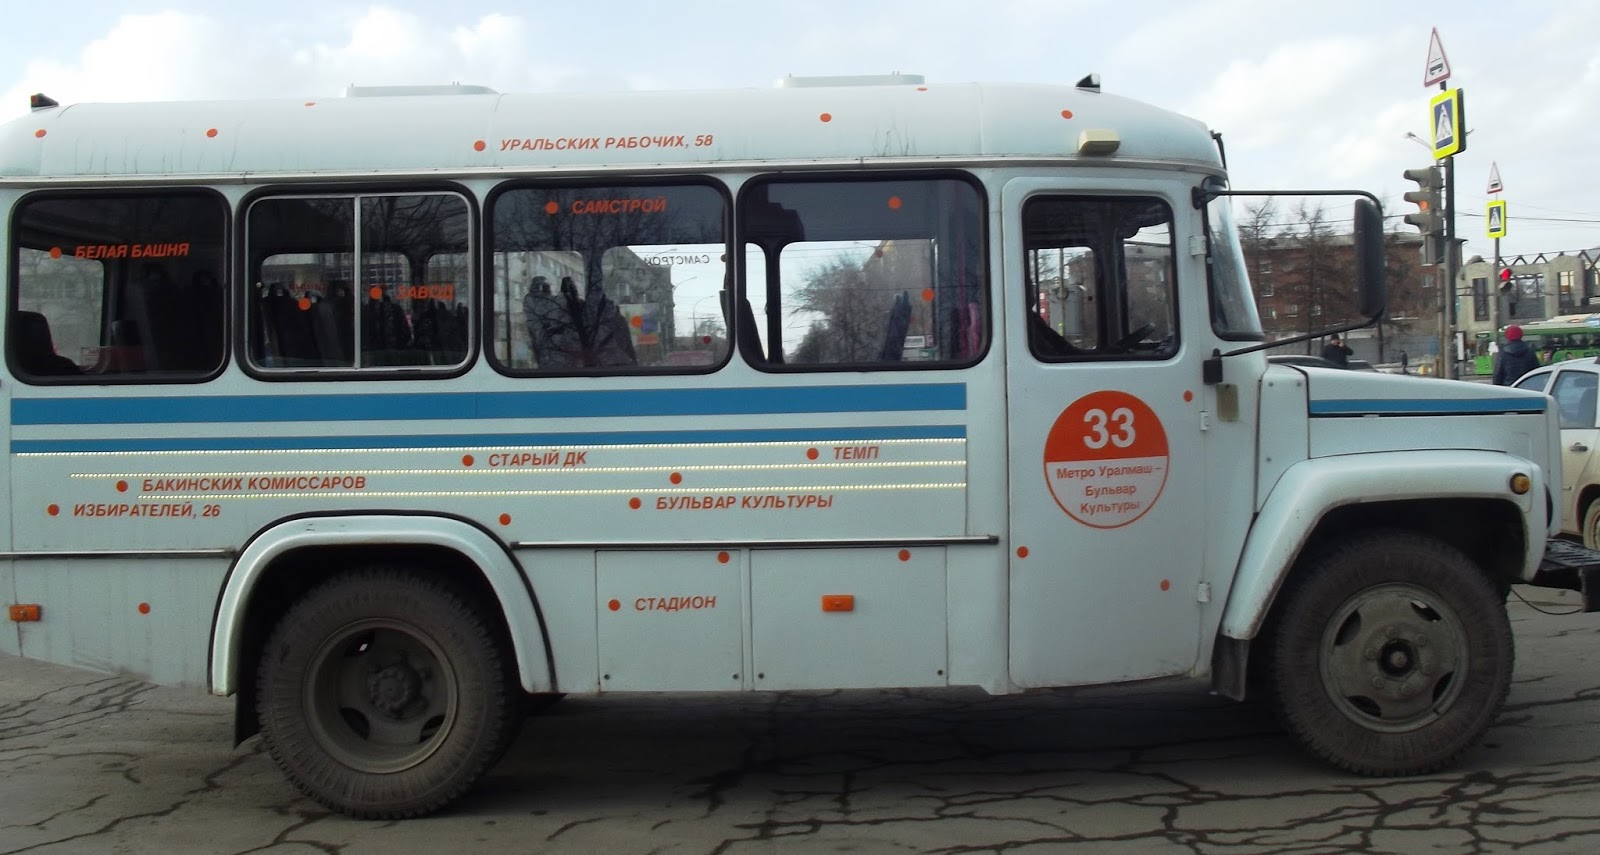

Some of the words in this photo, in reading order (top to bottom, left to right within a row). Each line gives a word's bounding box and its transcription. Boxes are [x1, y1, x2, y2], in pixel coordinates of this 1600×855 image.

[500, 137, 600, 152] УРАЛЬСКИХ
[605, 135, 690, 150] РАБОЧИХ,
[695, 134, 713, 147] 58
[571, 197, 666, 215] САМСТРОЙ
[74, 244, 128, 260] БЕЛАЯ
[130, 242, 190, 258] БАШНЯ
[397, 284, 454, 301] ЗАВОД
[1082, 407, 1136, 449] 33
[488, 450, 559, 467] СТАРЫЙ
[562, 451, 588, 467] ДК
[833, 446, 879, 460] ТЕМП
[1056, 467, 1096, 480] Метро
[1098, 464, 1152, 478] Уралмаш
[142, 477, 244, 492] БАКИНСКИХ
[247, 475, 367, 491] КОМИССАРОВ
[1085, 484, 1136, 498] Бульвар
[73, 501, 199, 519] ИЗБИРАТЕЛЕЙ,
[202, 504, 221, 518] 26
[656, 495, 736, 511] БУЛЬВАР
[741, 493, 834, 510] КУЛЬТУРЫ
[1080, 501, 1140, 515] Культуры
[635, 595, 717, 612] СТАДИОН
